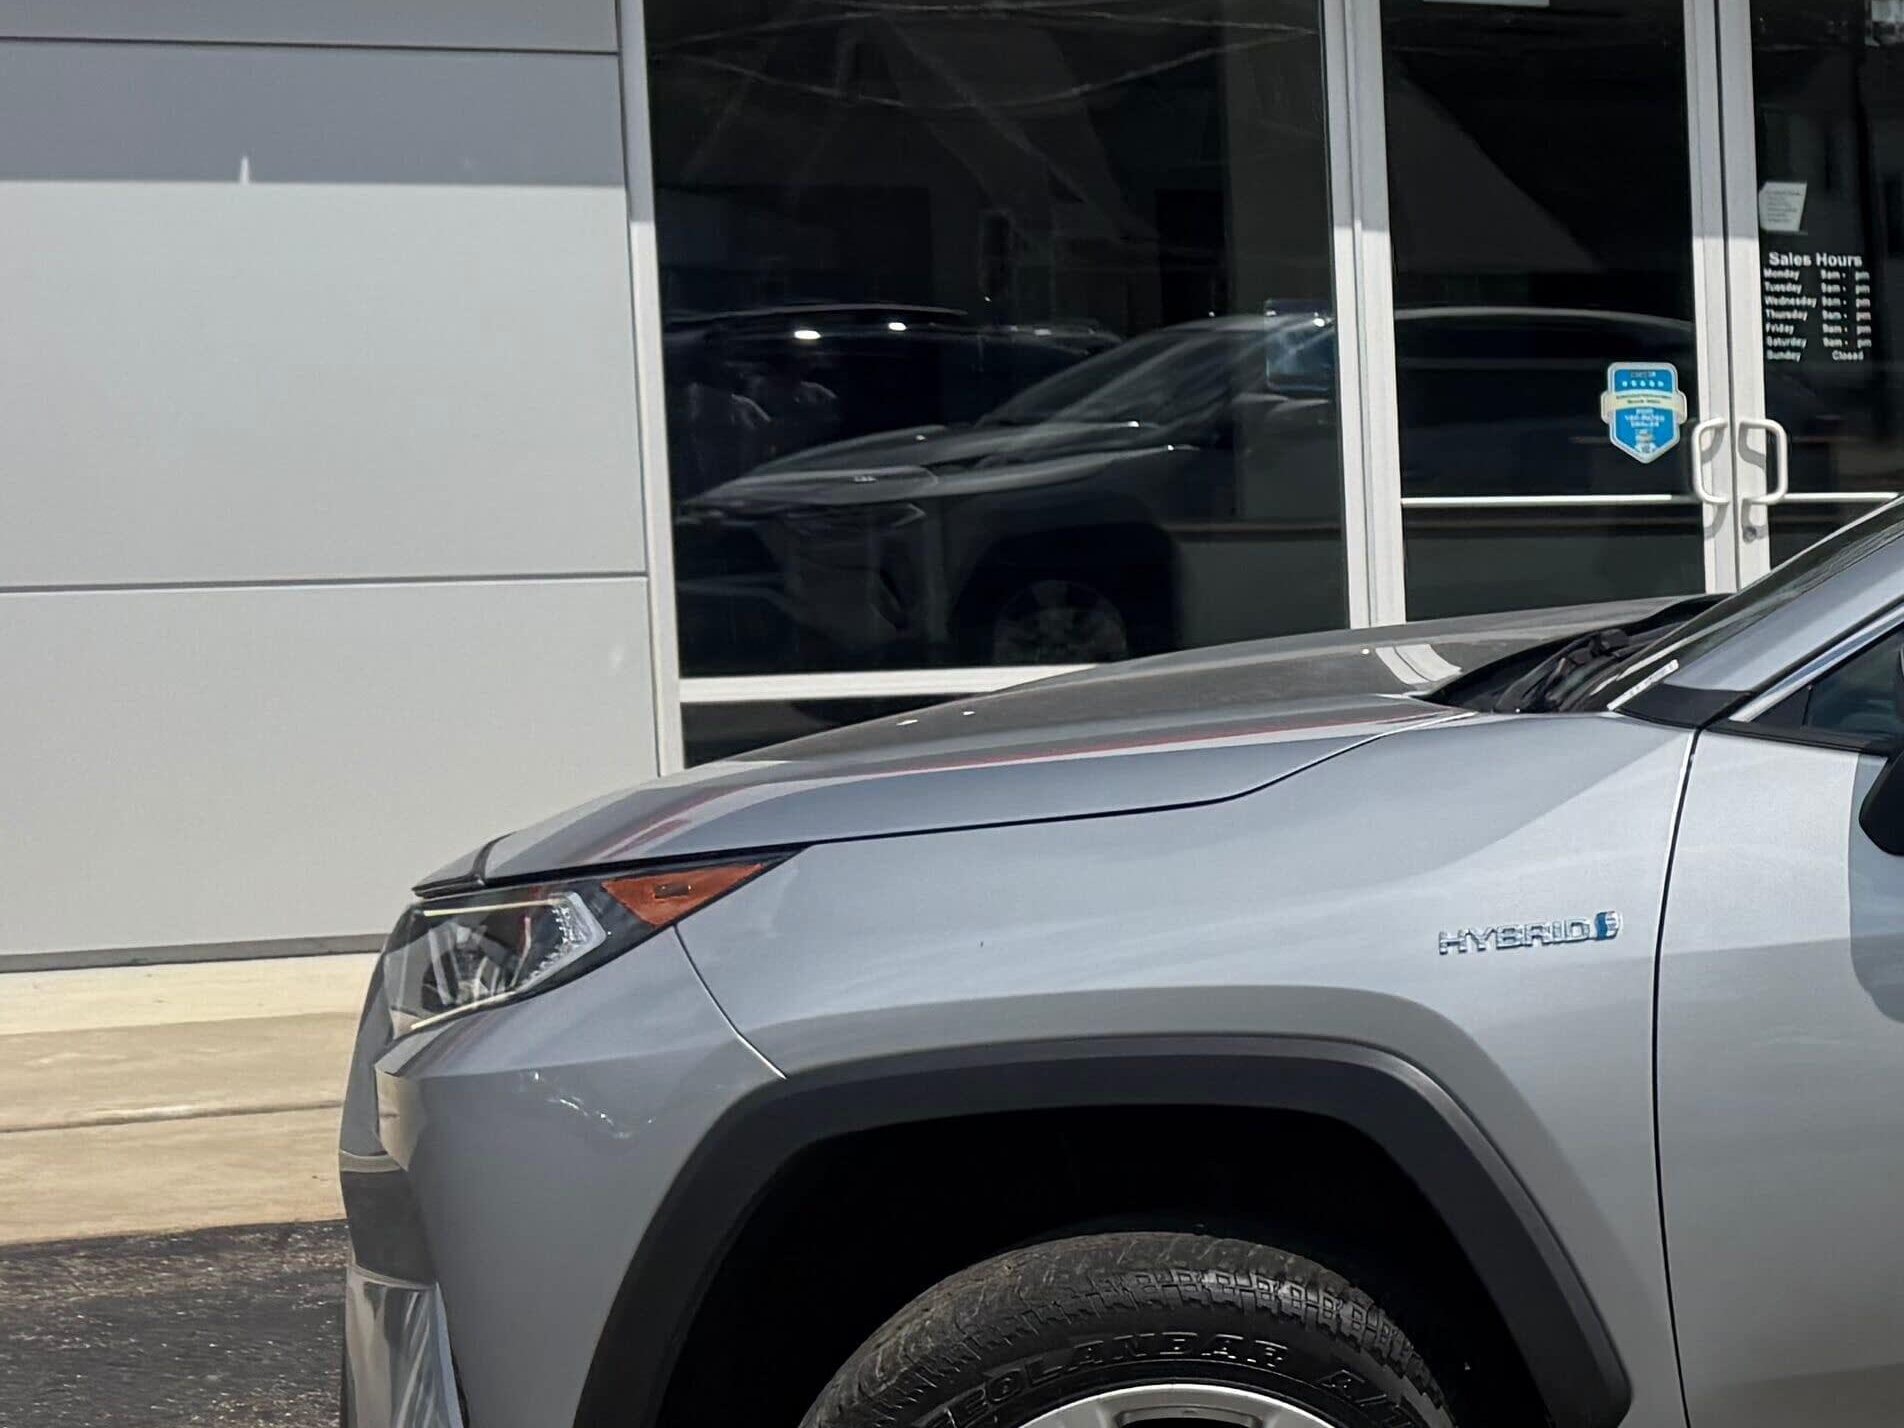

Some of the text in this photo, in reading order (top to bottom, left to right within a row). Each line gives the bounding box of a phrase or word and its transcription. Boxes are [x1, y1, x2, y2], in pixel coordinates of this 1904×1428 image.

[1769, 252, 1863, 267] Sales Hours
[1832, 350, 1864, 361] Closed
[1438, 917, 1591, 956] HYBRID
